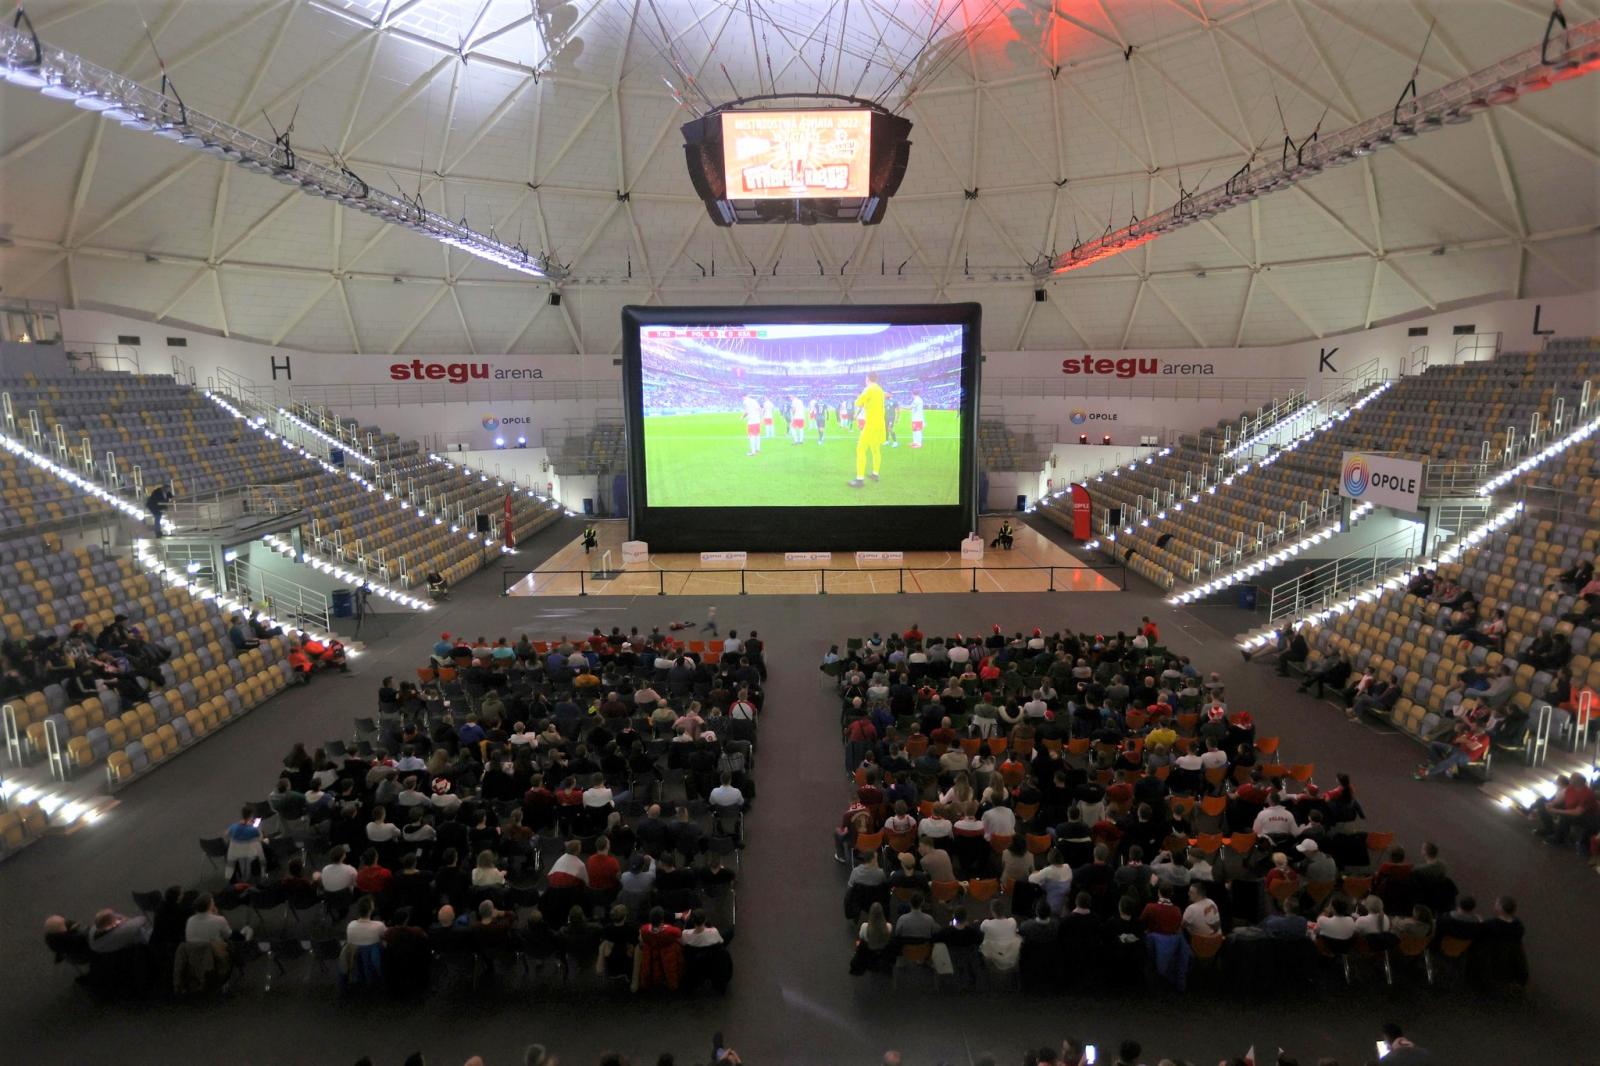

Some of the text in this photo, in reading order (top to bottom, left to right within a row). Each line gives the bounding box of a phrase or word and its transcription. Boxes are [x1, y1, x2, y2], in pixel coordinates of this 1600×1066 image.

[1533, 304, 1555, 335] L
[271, 355, 292, 380] H
[390, 359, 543, 384] stegu arena
[1062, 354, 1214, 379] stegu arena
[1319, 347, 1339, 373] K
[502, 416, 531, 425] OPOLE
[1089, 413, 1118, 421] OPOLE
[1371, 472, 1416, 494] OPOLE
